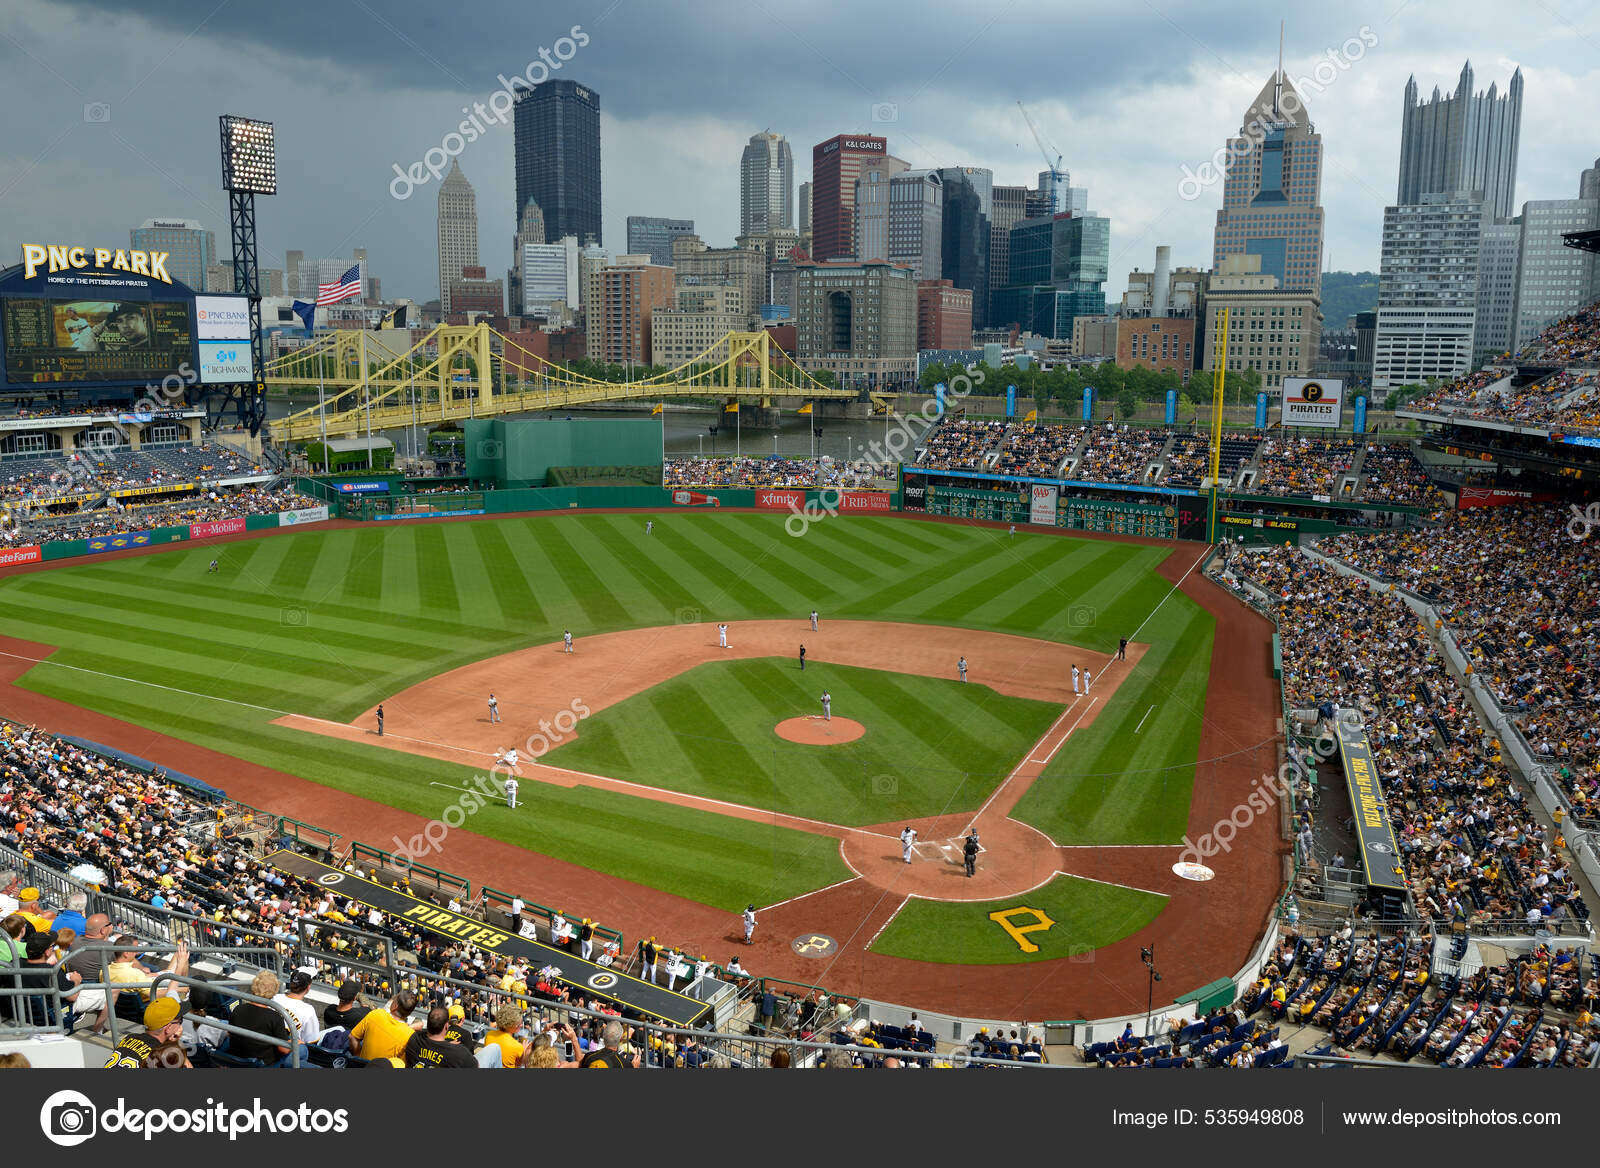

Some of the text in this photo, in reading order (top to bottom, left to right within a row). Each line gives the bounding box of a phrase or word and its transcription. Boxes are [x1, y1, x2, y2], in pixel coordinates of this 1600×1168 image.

[860, 142, 882, 150] GATES
[22, 243, 173, 285] PNC PARK
[48, 276, 66, 284] HOME
[88, 278, 125, 286] PITTSBURGH
[208, 312, 248, 320] PNC BANK
[207, 366, 249, 374] HIGHMARK
[256, 384, 264, 394] P
[1290, 404, 1332, 414] PIRATES
[762, 493, 798, 506] xfinity
[937, 491, 980, 500] NATIONAL
[1493, 490, 1532, 498] BOWTIE
[842, 494, 868, 508] TRIB
[1070, 504, 1162, 516] AMERICAN LEAGUE
[1225, 516, 1252, 524] BOWSER
[1270, 521, 1296, 529] BLASTS
[0, 551, 36, 564] ateFarm
[404, 904, 509, 948] PIRATES
[988, 904, 1056, 954] P
[668, 958, 676, 966] 28
[418, 1048, 444, 1064] JONES
